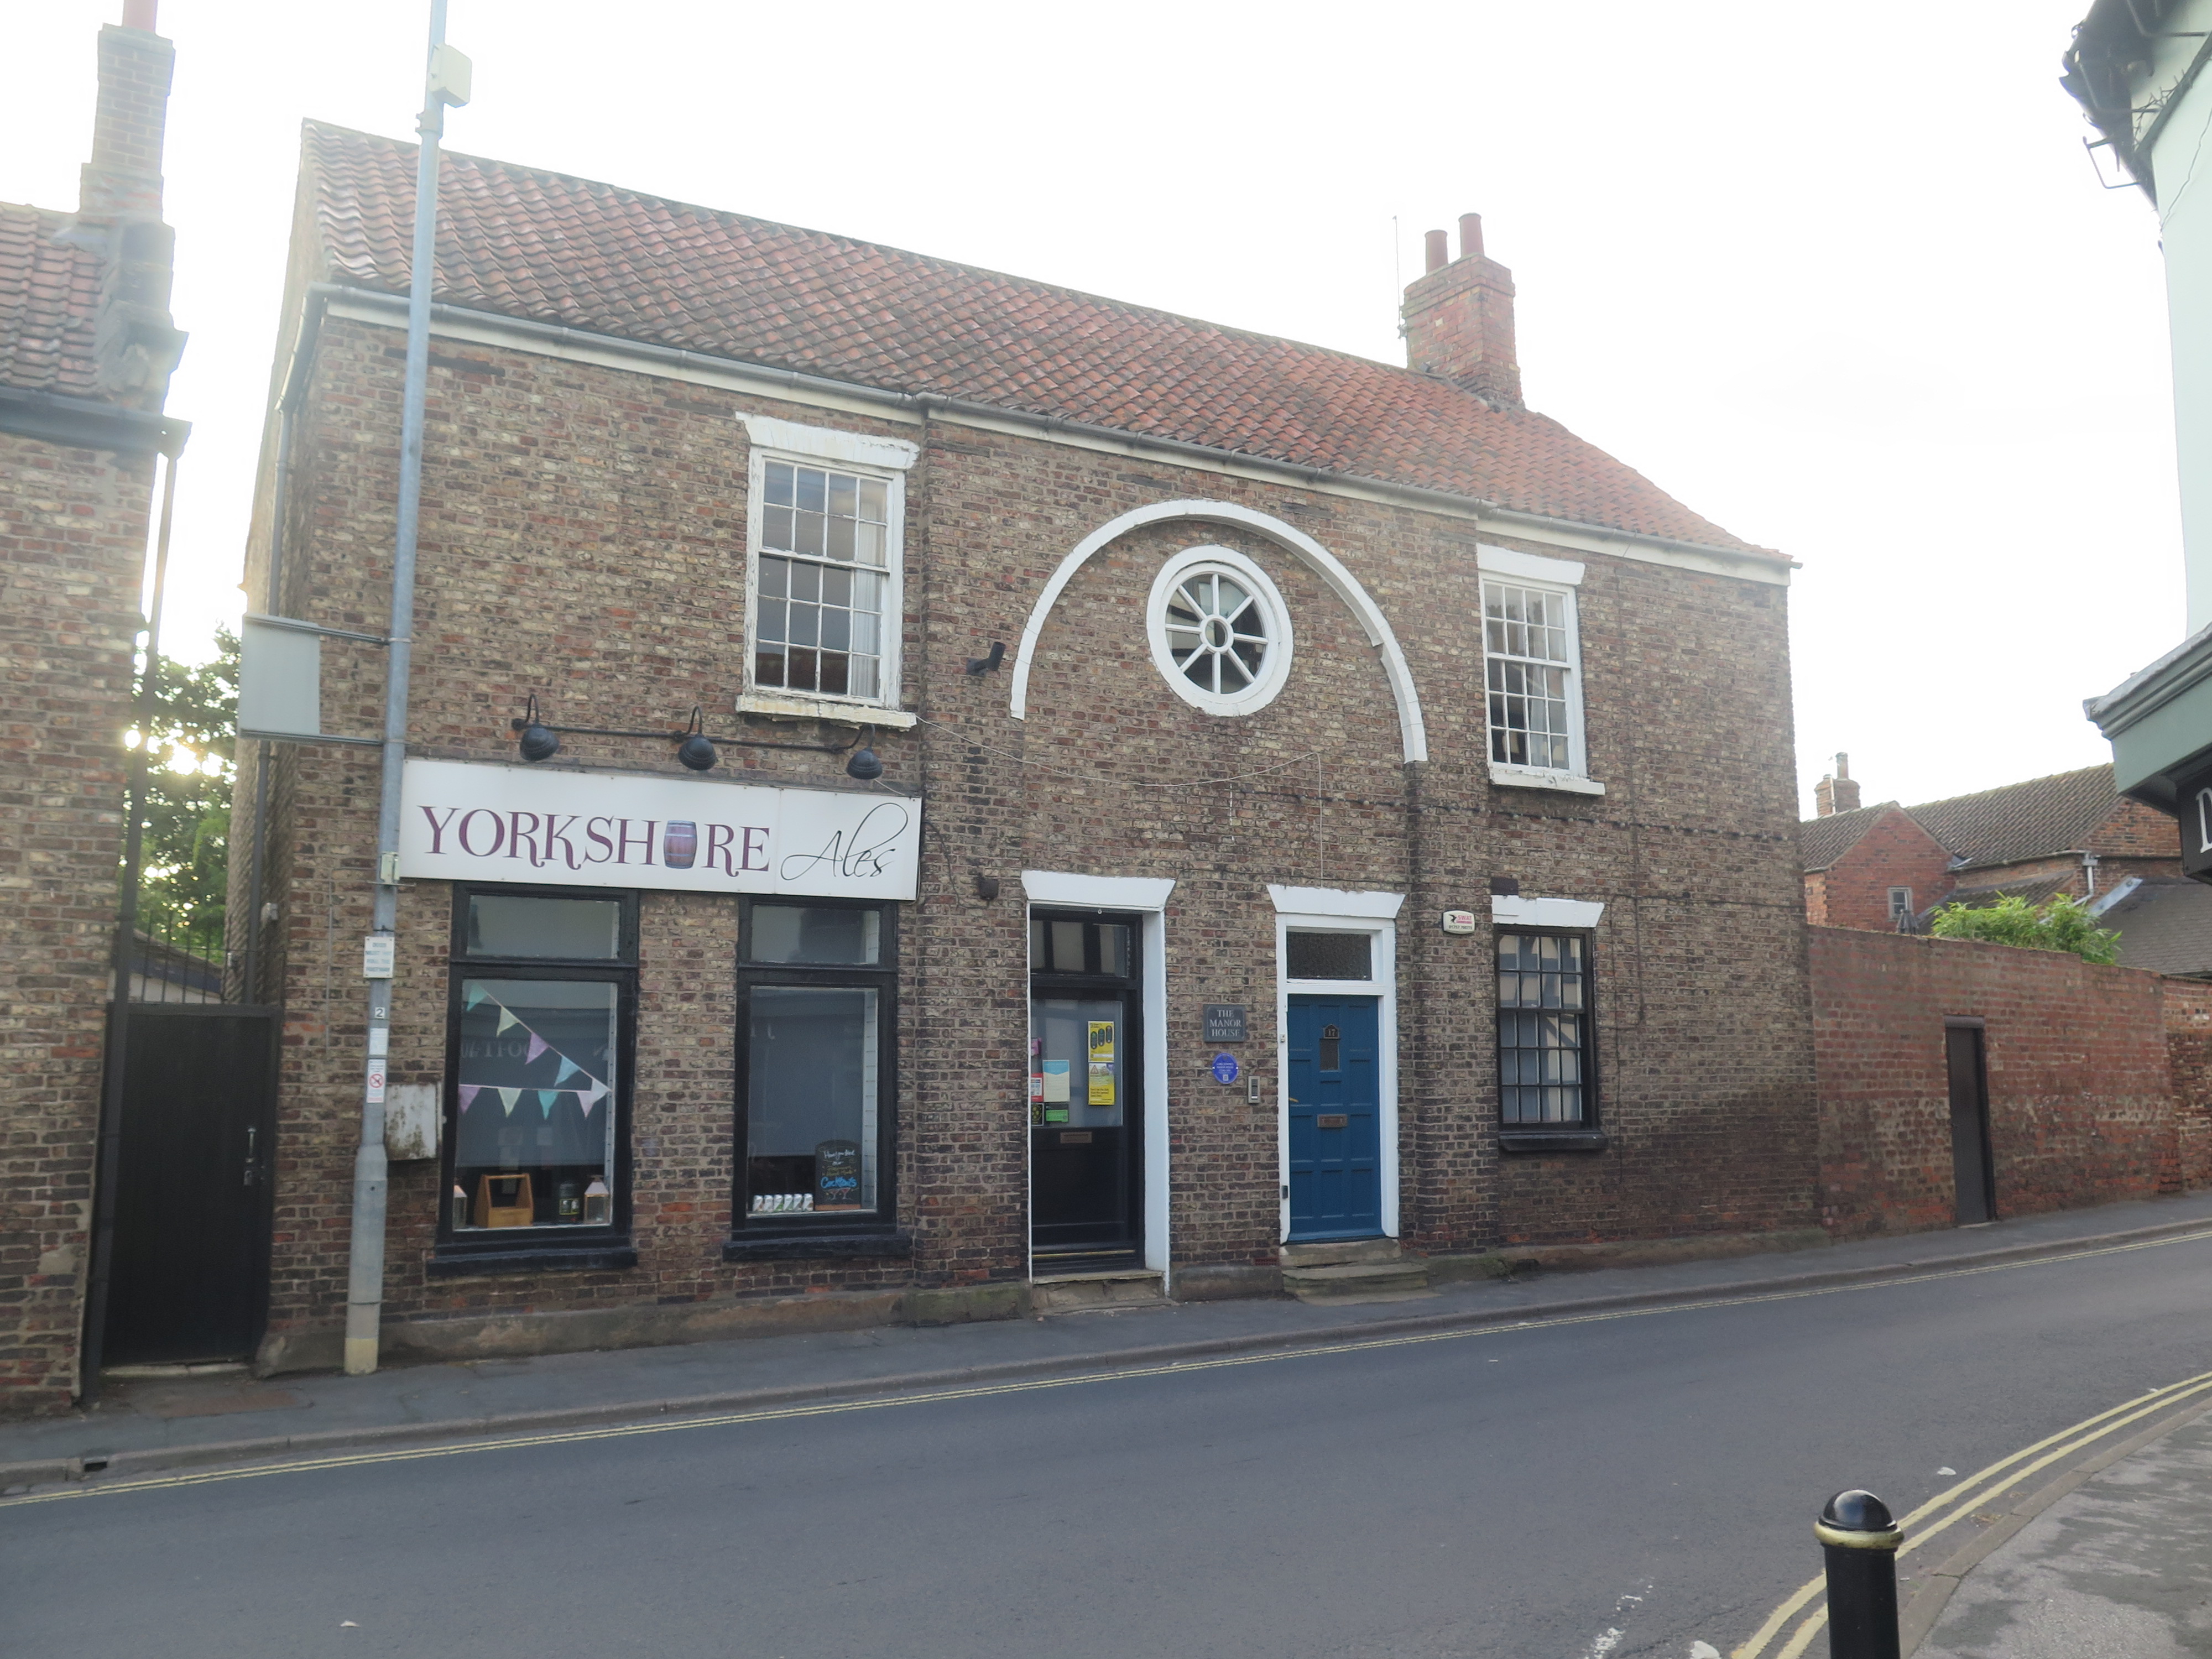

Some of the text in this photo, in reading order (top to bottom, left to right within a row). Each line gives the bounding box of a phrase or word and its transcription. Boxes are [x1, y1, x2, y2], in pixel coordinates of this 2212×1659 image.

[416, 801, 909, 881] YORKSHRE Ales
[376, 1008, 383, 1018] 2
[1217, 1009, 1234, 1018] THE
[1209, 1019, 1242, 1027] MANOR
[1212, 1029, 1240, 1037] HOUSE
